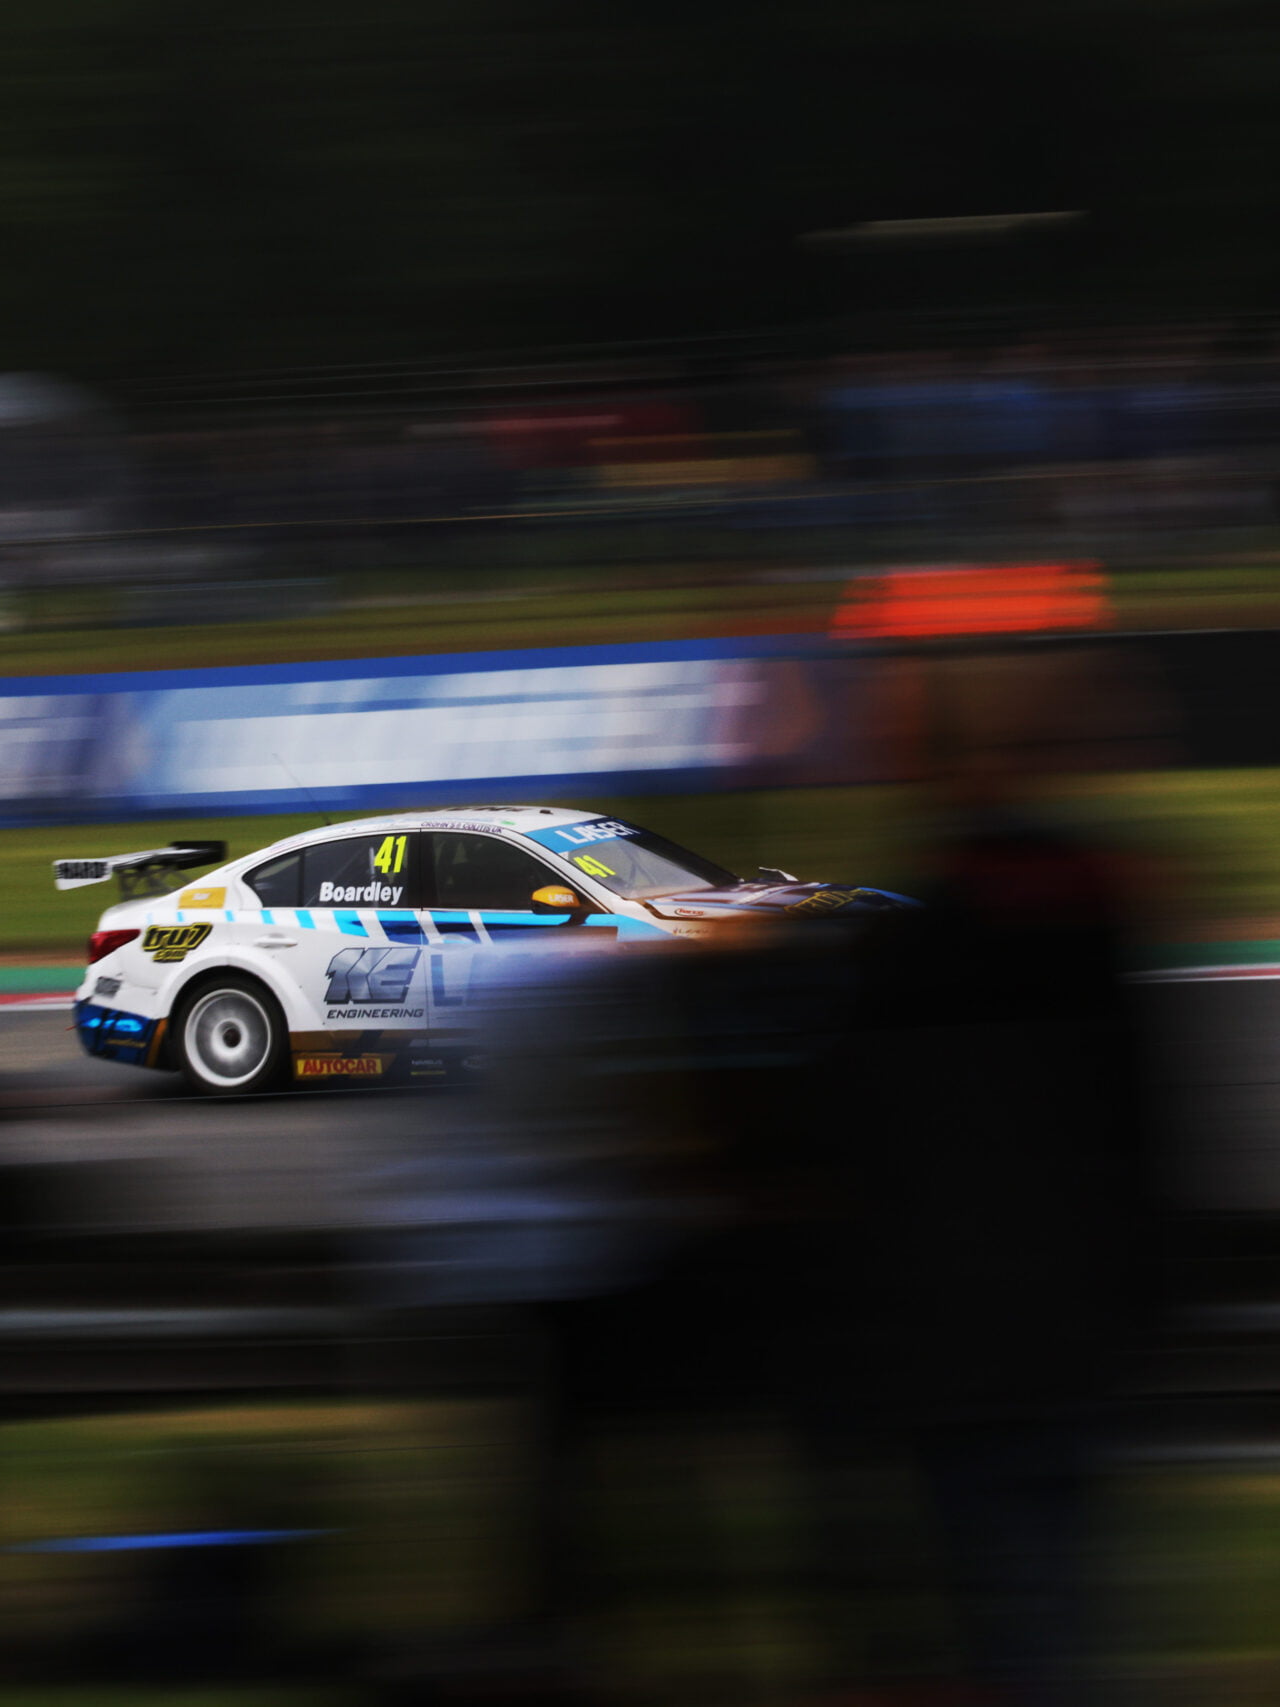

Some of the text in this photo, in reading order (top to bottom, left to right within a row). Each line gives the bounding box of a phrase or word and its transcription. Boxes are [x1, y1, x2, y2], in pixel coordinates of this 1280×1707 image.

[554, 821, 641, 845] LASER
[374, 835, 407, 874] 41
[573, 854, 617, 878] 41
[319, 881, 404, 906] Boardley
[326, 1008, 424, 1020] ENGINEERING
[303, 1060, 377, 1074] AUTOCAR
